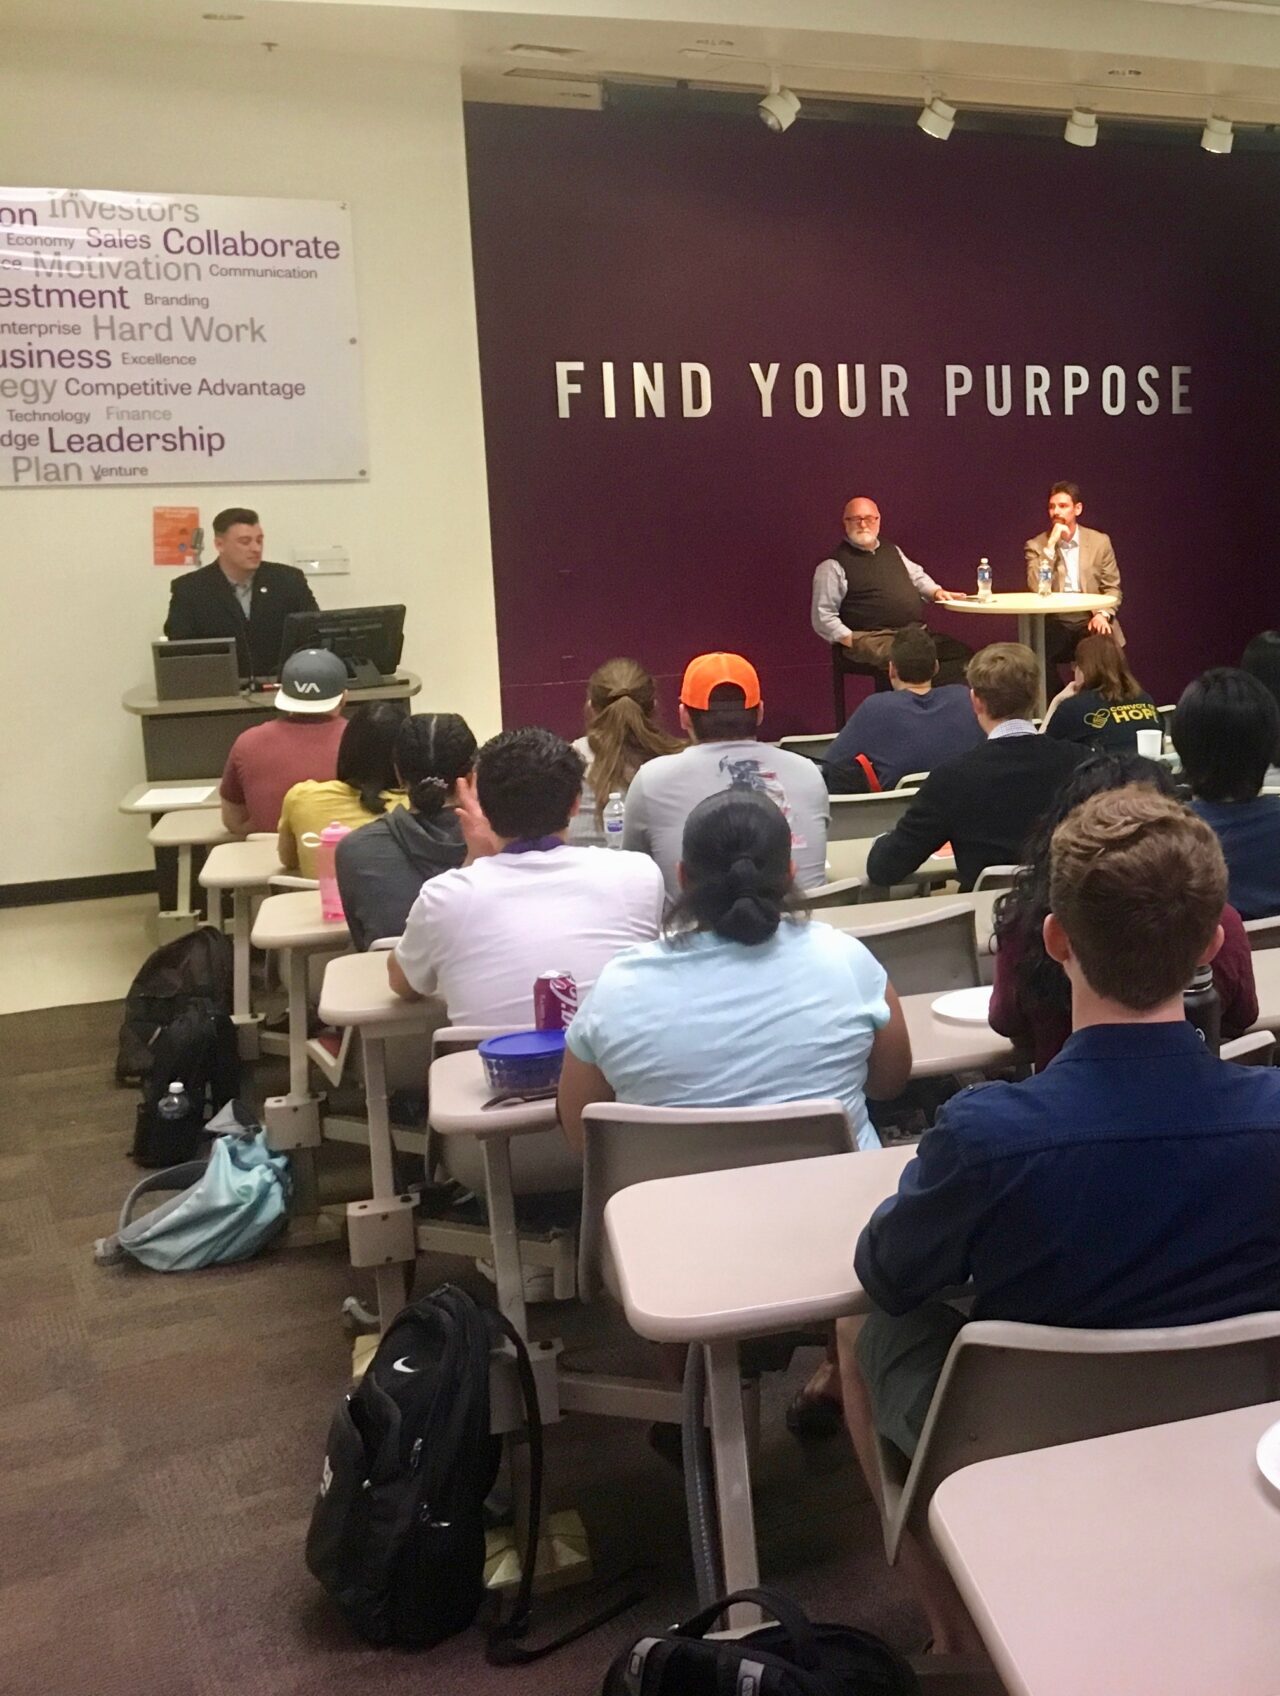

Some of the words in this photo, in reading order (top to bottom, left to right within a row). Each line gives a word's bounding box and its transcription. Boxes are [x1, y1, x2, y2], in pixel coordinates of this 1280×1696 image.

[48, 192, 200, 223] Investors
[6, 232, 75, 249] Economy
[86, 226, 151, 249] Sales
[163, 227, 341, 259] Collaborate
[33, 250, 201, 281] Motivation
[209, 264, 318, 279] Communication
[0, 284, 130, 309] estment
[144, 292, 209, 309] Branding
[0, 319, 82, 338] nterprise
[93, 314, 173, 342] Hard
[181, 316, 267, 342] Work
[121, 352, 197, 365] Excellence
[0, 378, 58, 404] egy
[65, 377, 192, 399] Competitive
[198, 378, 305, 400] Advantage
[555, 361, 712, 418] FIND
[749, 362, 910, 418] YOUR
[945, 364, 1192, 417] PURPOSE
[7, 409, 91, 424] Technology
[106, 406, 172, 421] Finance
[0, 429, 40, 450] dge
[48, 426, 226, 456] Leadership
[12, 456, 83, 482] Plan
[90, 464, 149, 479] Venture
